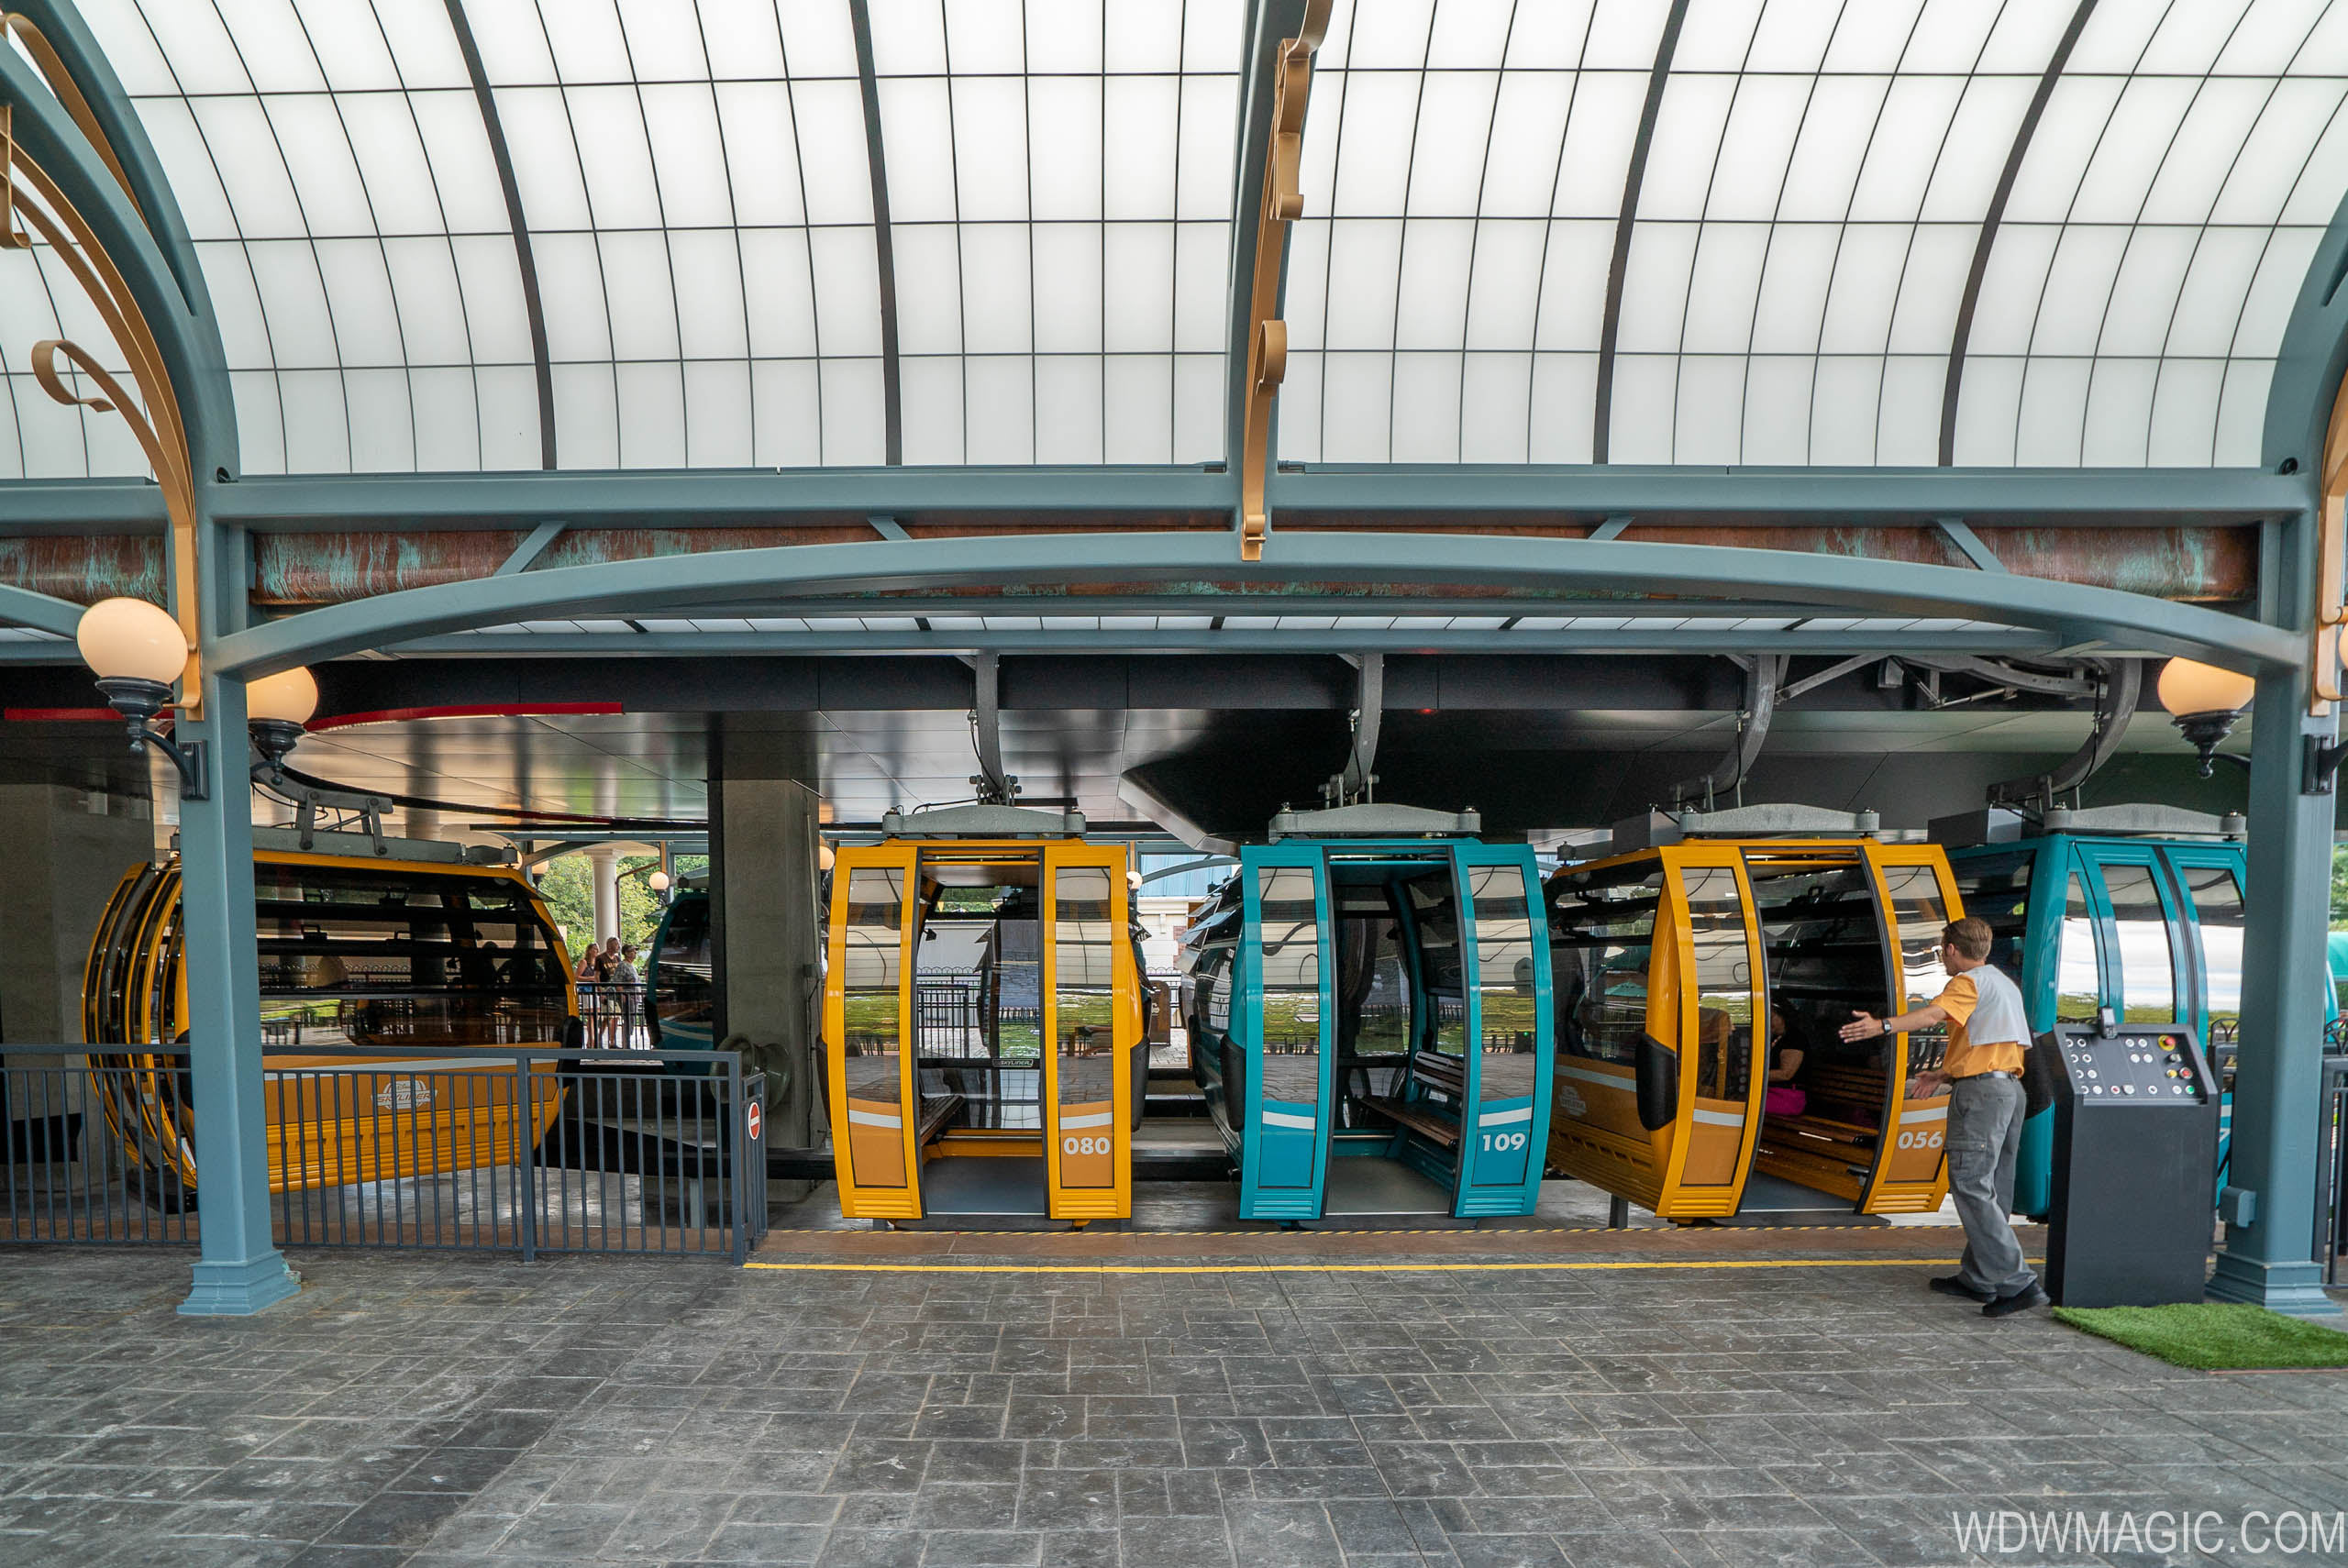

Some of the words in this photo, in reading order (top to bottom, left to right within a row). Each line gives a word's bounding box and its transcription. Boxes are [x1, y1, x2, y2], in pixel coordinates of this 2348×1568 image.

[1064, 1136, 1111, 1154] 080
[1482, 1132, 1526, 1152] 109
[1898, 1131, 1944, 1150] 056
